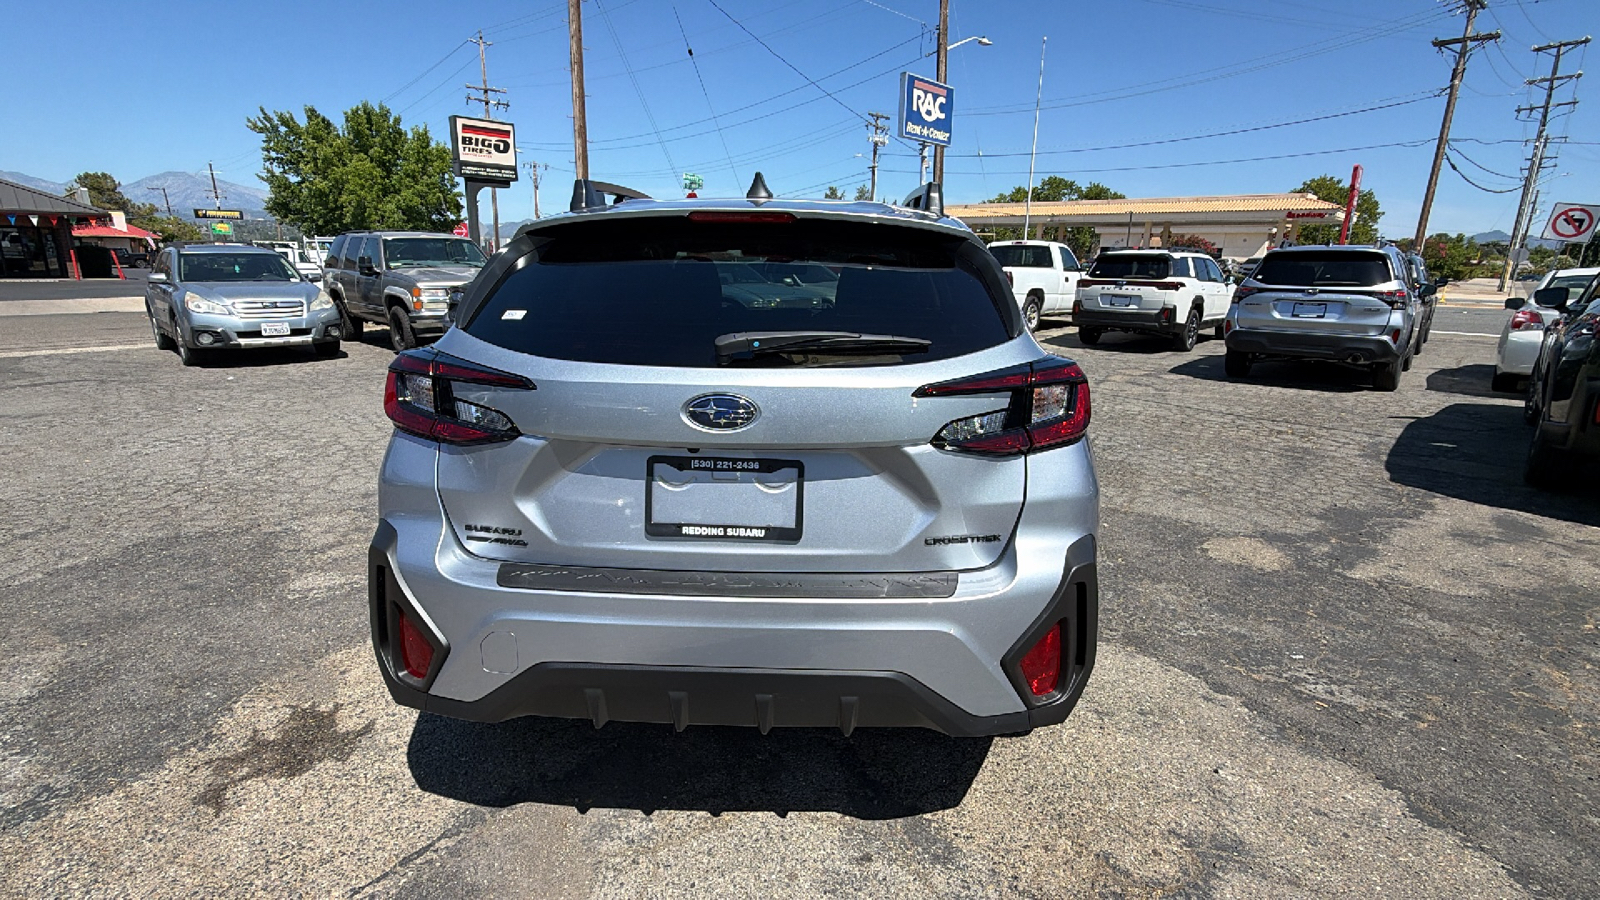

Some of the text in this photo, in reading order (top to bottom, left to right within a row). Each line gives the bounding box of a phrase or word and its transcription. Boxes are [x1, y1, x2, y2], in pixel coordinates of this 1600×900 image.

[912, 88, 946, 122] RAC
[906, 122, 950, 141] Rent-A-Center
[462, 136, 492, 148] BIG
[691, 460, 760, 469] (530) 221-2436
[465, 524, 522, 535] SUBARU
[682, 526, 765, 537] REDDING SUBARU
[924, 534, 1001, 546] CROSSTREK
